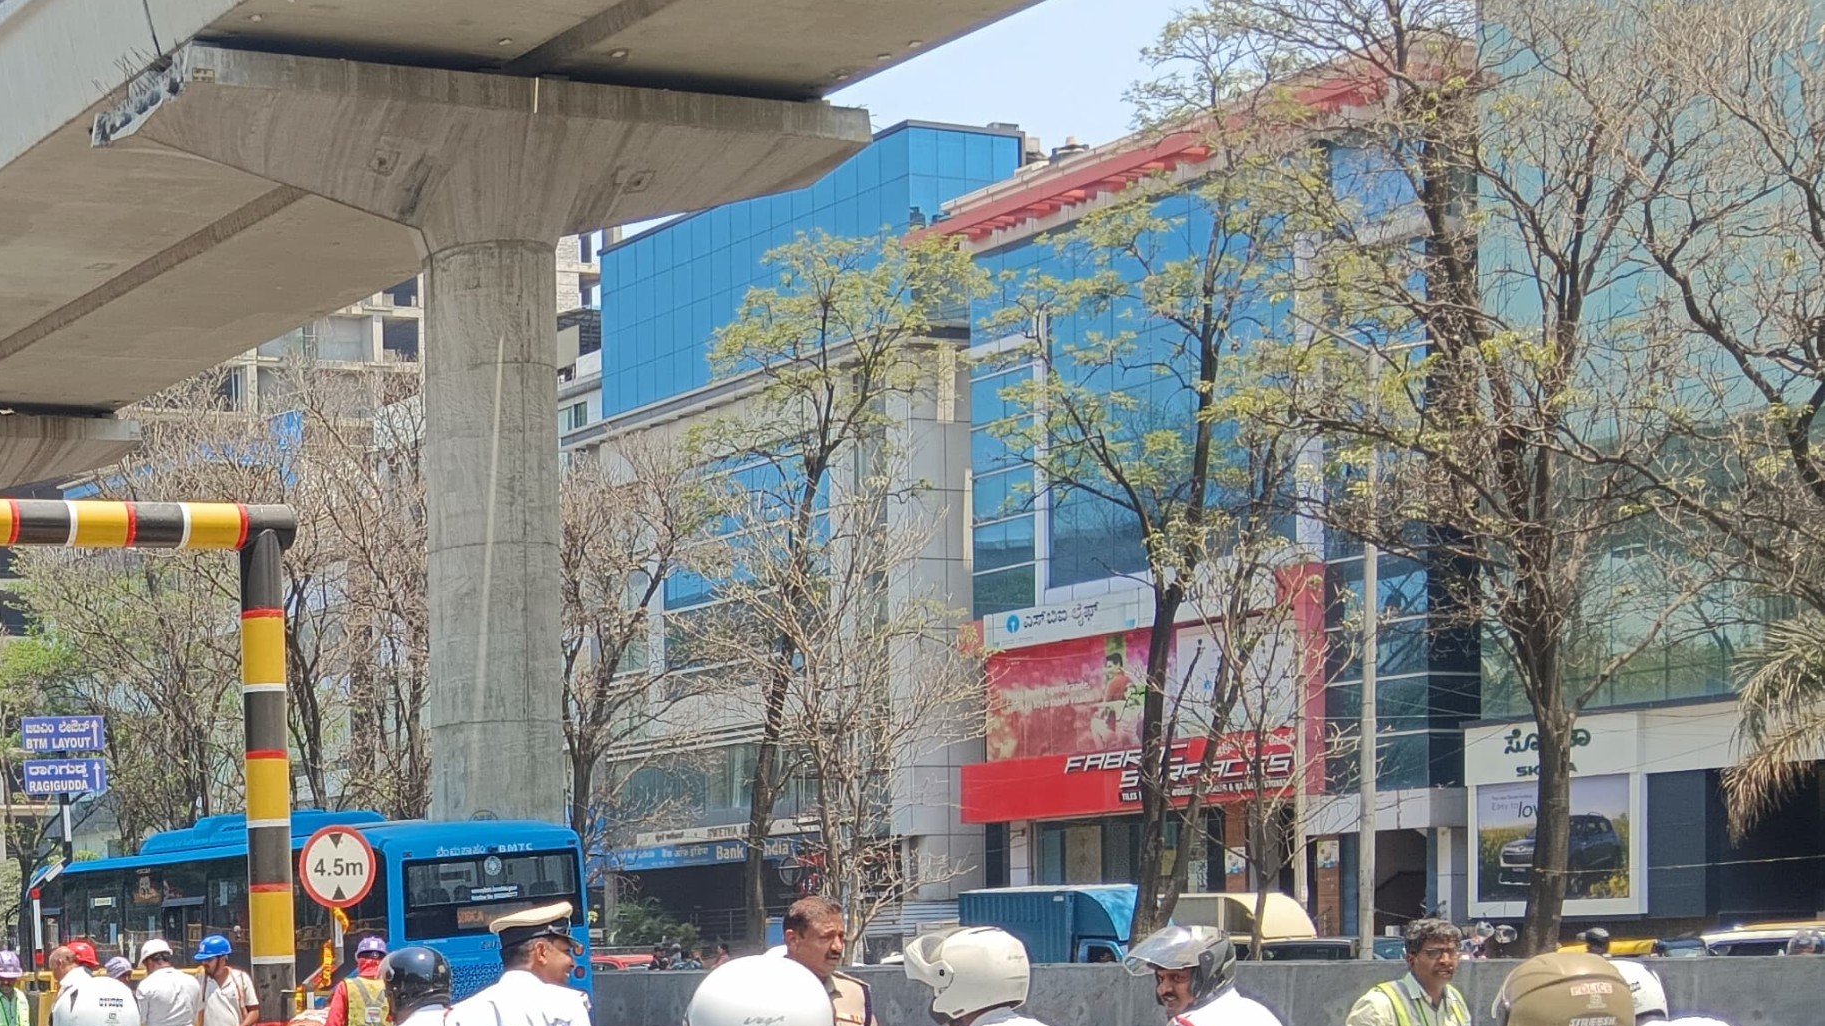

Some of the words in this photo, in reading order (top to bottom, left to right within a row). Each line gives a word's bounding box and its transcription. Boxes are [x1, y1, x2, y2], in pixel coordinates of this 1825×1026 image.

[26, 738, 48, 749] BTM
[52, 736, 92, 749] LAYOUT
[29, 780, 89, 792] RAGIGUDDA
[498, 843, 534, 853] BMTC
[716, 844, 744, 860] Bank
[314, 858, 363, 876] 4.5m
